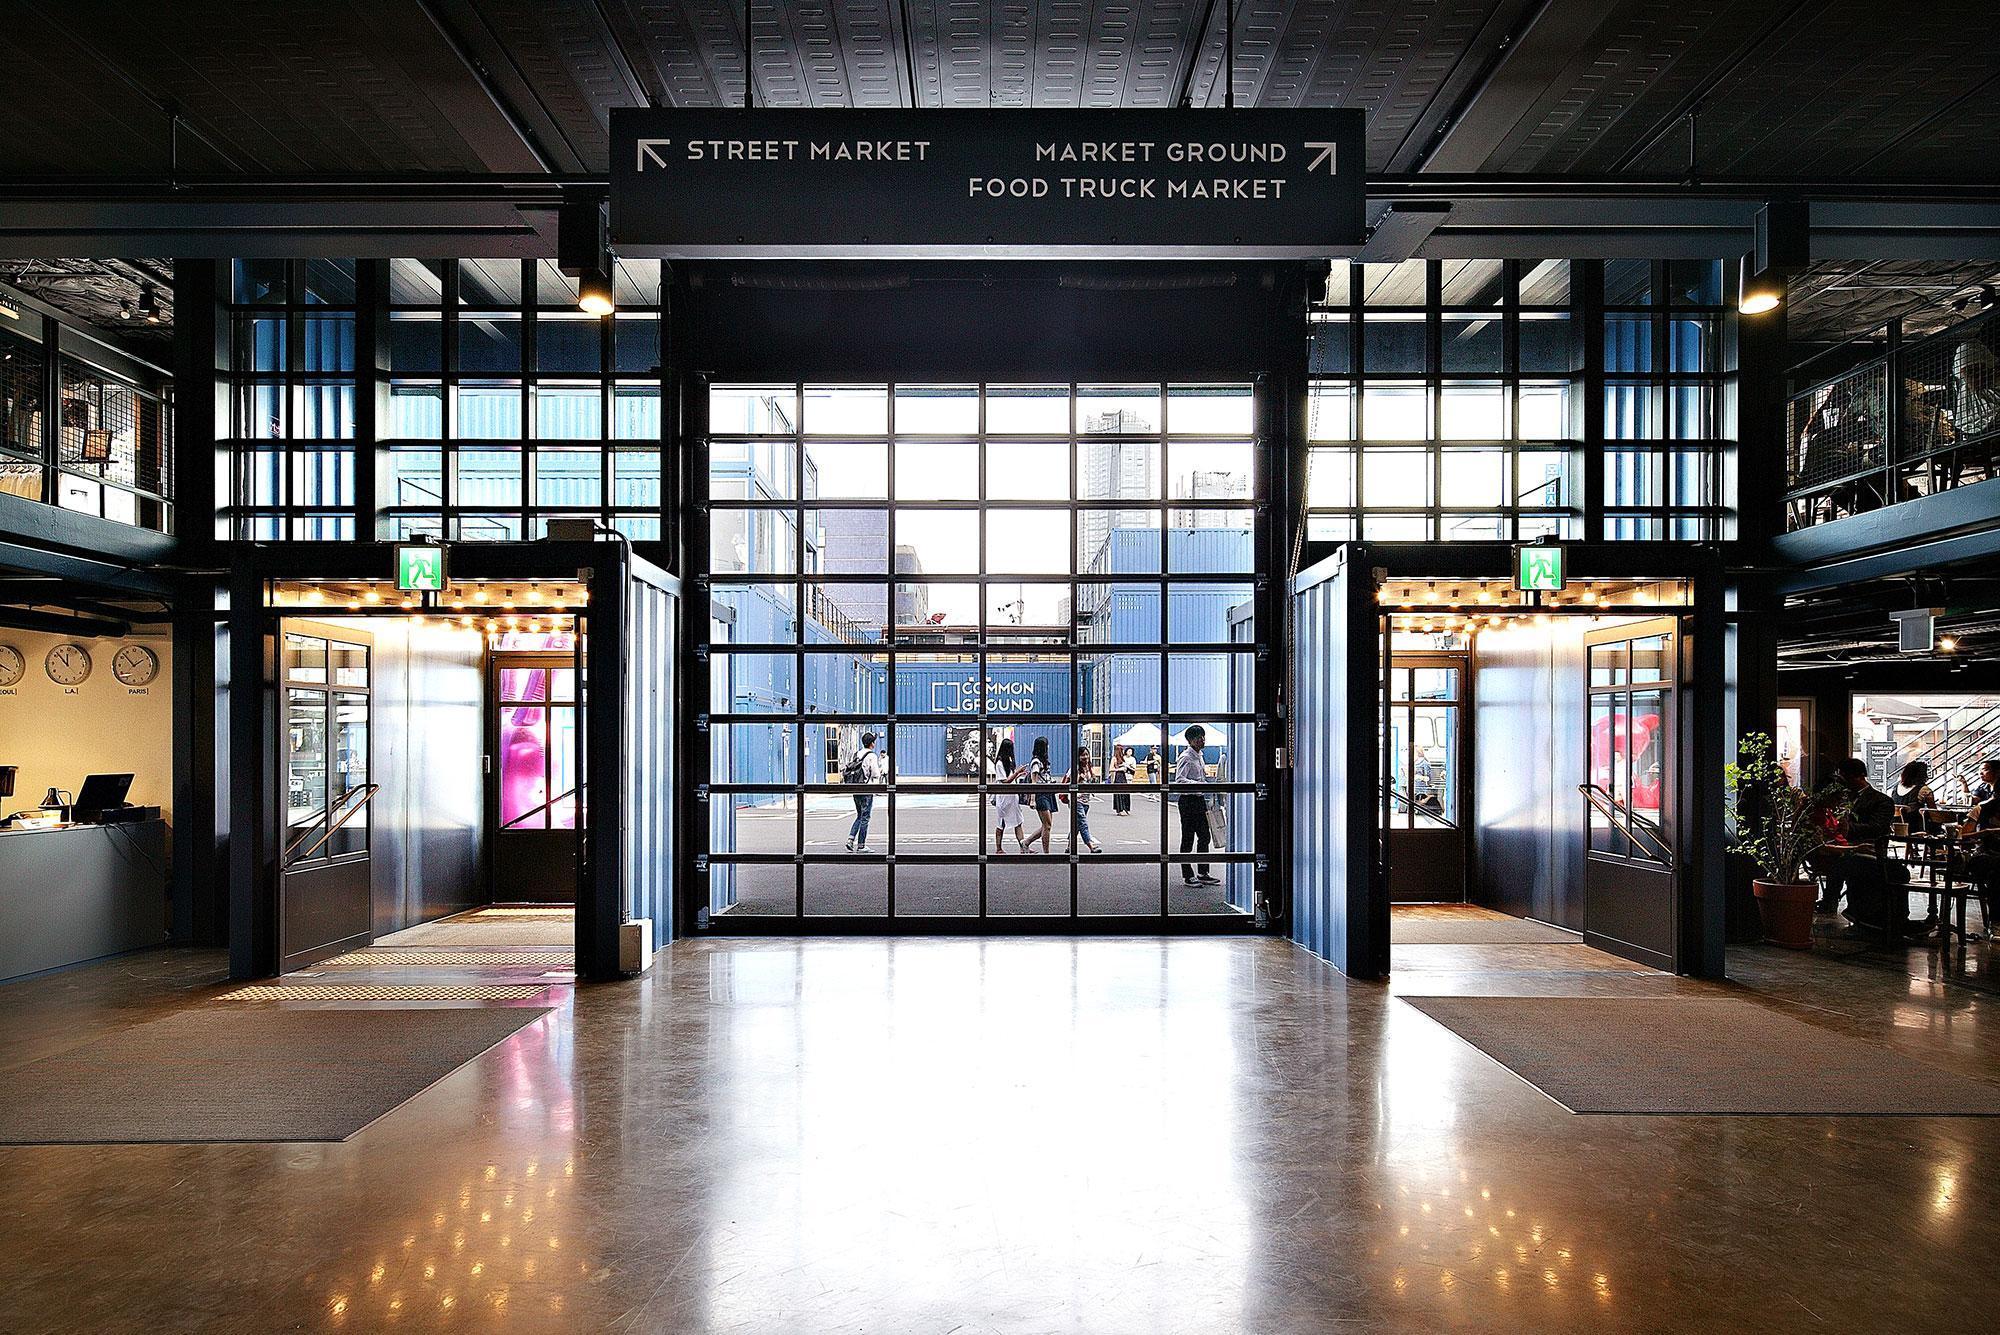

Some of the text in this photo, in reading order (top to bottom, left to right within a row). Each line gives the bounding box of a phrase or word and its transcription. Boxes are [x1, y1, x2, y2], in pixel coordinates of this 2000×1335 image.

[687, 140, 931, 161] STREET MARKET
[1036, 142, 1287, 163] MARKET GROUND
[969, 177, 1286, 199] FOOD TRUCK MARKET
[962, 682, 1034, 695] COMMON
[962, 698, 1034, 711] GROUND
